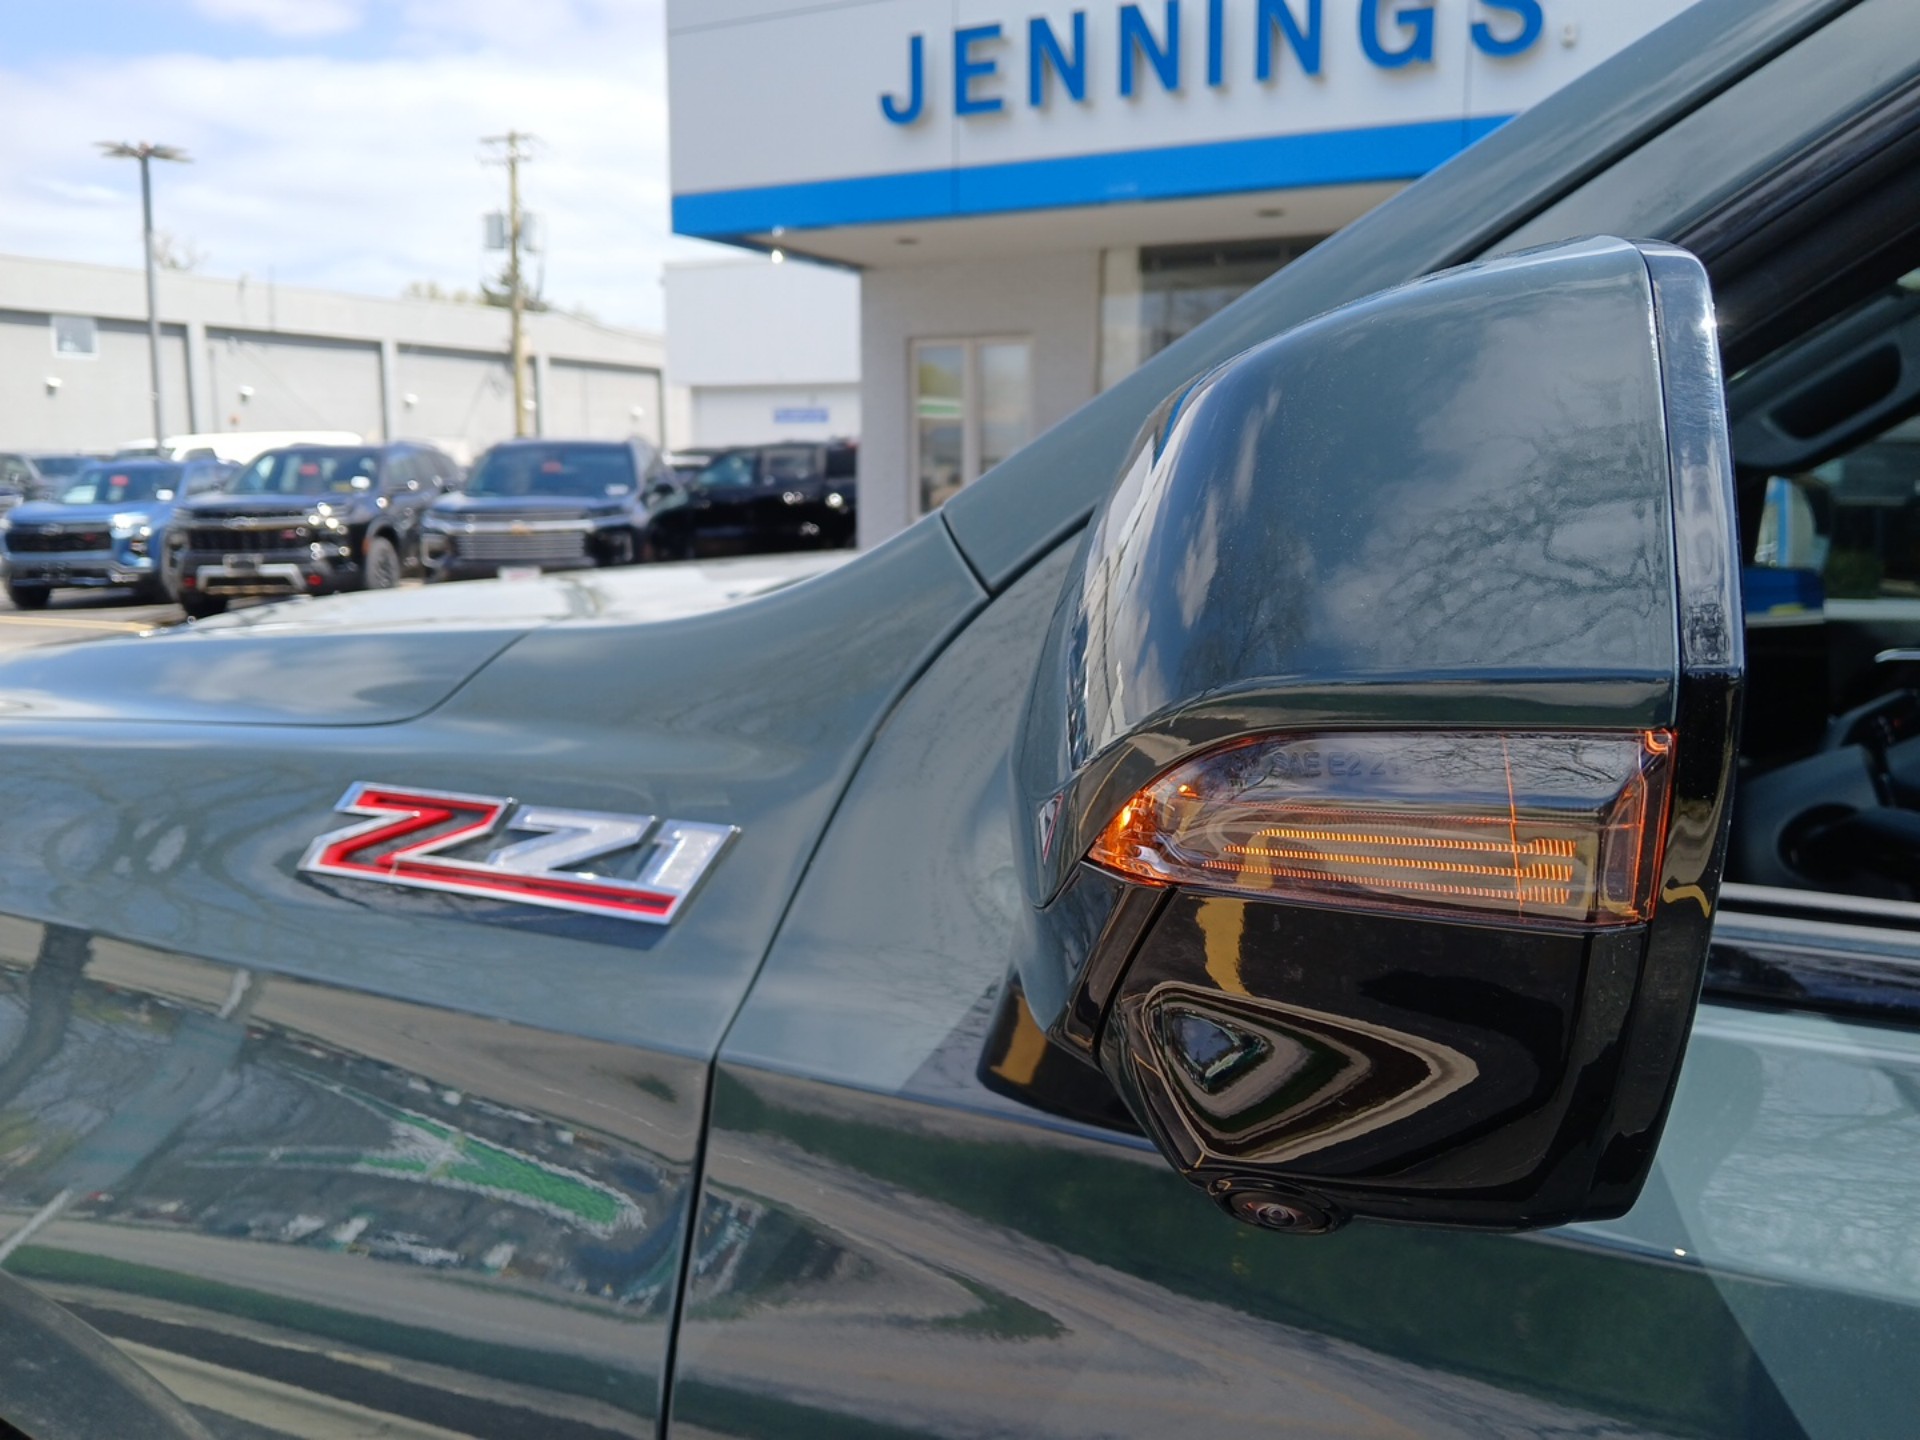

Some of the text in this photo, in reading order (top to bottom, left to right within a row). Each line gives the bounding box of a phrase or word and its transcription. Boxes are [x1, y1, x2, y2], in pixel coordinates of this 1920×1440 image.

[880, 0, 1544, 126] JENNINGS
[1270, 752, 1322, 778] SAE
[1328, 752, 1362, 777] E2
[298, 780, 742, 925] Z71
